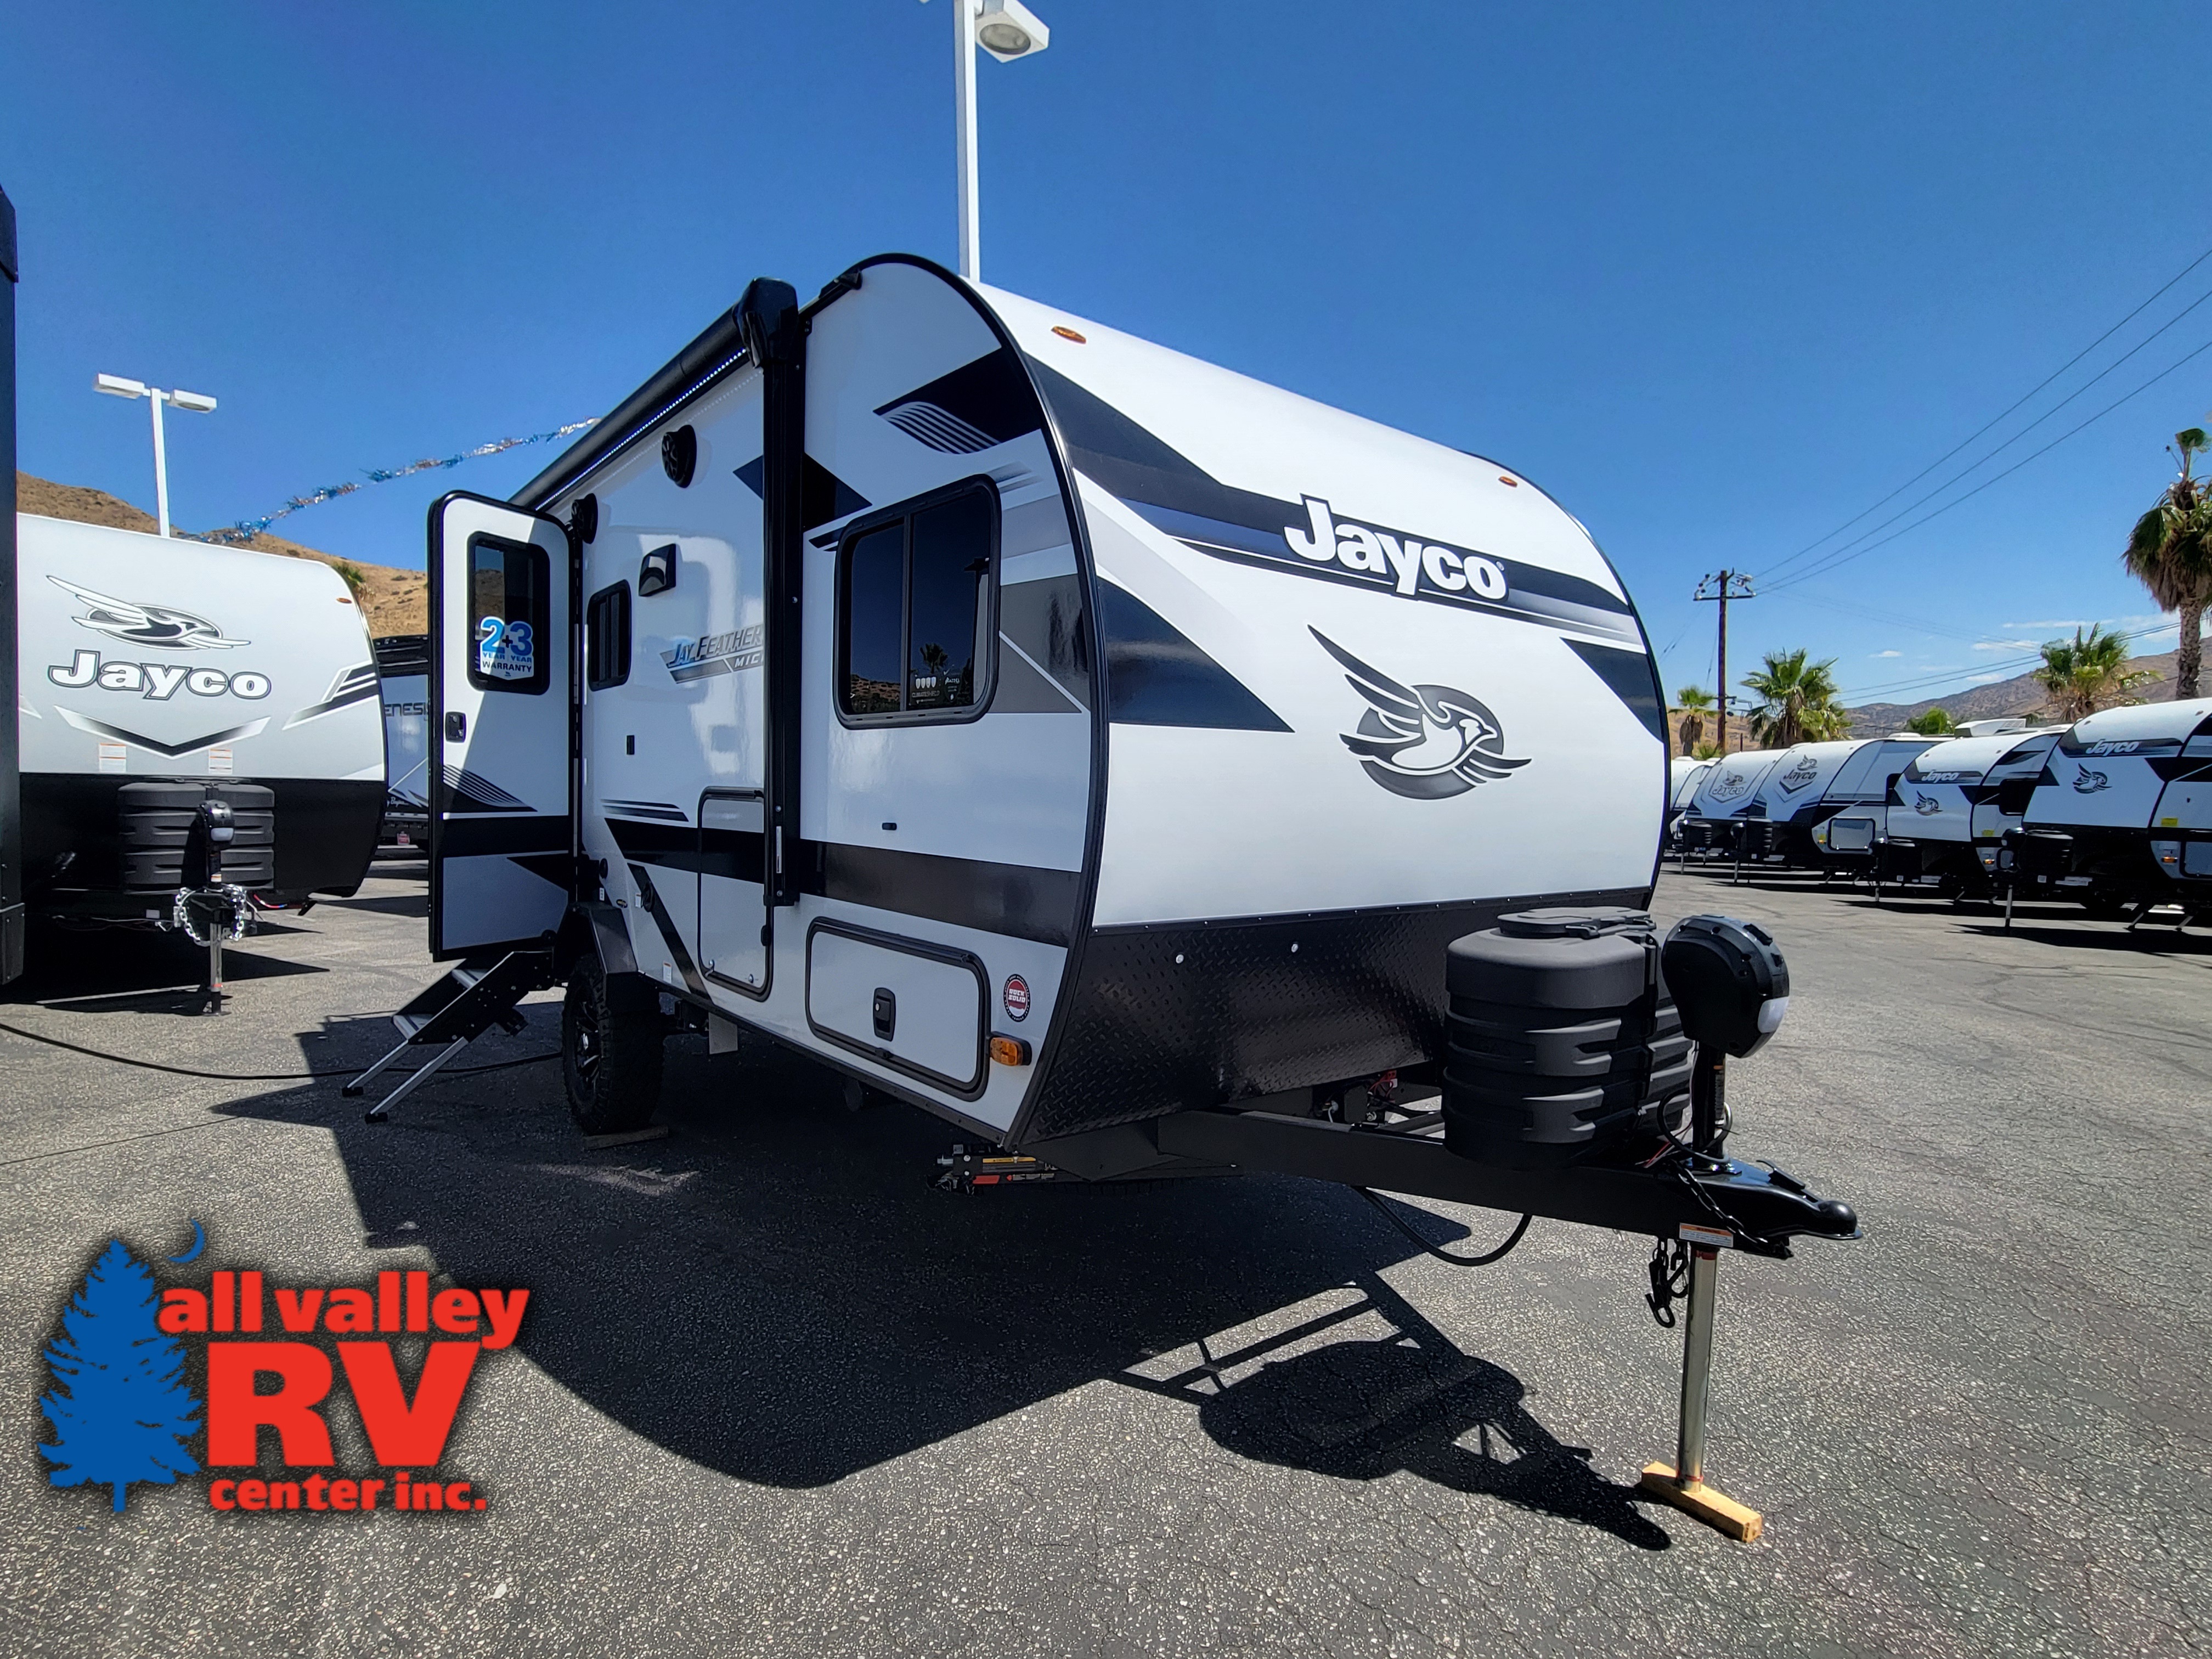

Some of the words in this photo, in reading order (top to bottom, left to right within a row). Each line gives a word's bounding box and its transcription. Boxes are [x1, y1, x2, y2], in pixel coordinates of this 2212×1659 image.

[1284, 498, 1507, 600] Jayco
[667, 643, 695, 668] JAY
[695, 624, 763, 661] FEATHER
[483, 661, 532, 673] WARRANTY
[735, 652, 763, 668] MIC
[47, 649, 272, 701] Jayco
[384, 702, 426, 716] ENESI
[2086, 738, 2140, 757] Jayco
[1784, 769, 1817, 782] Jayco
[1921, 770, 1959, 783] Jayco
[1712, 785, 1743, 797] Jayco
[1008, 994, 1026, 1003] SOLID
